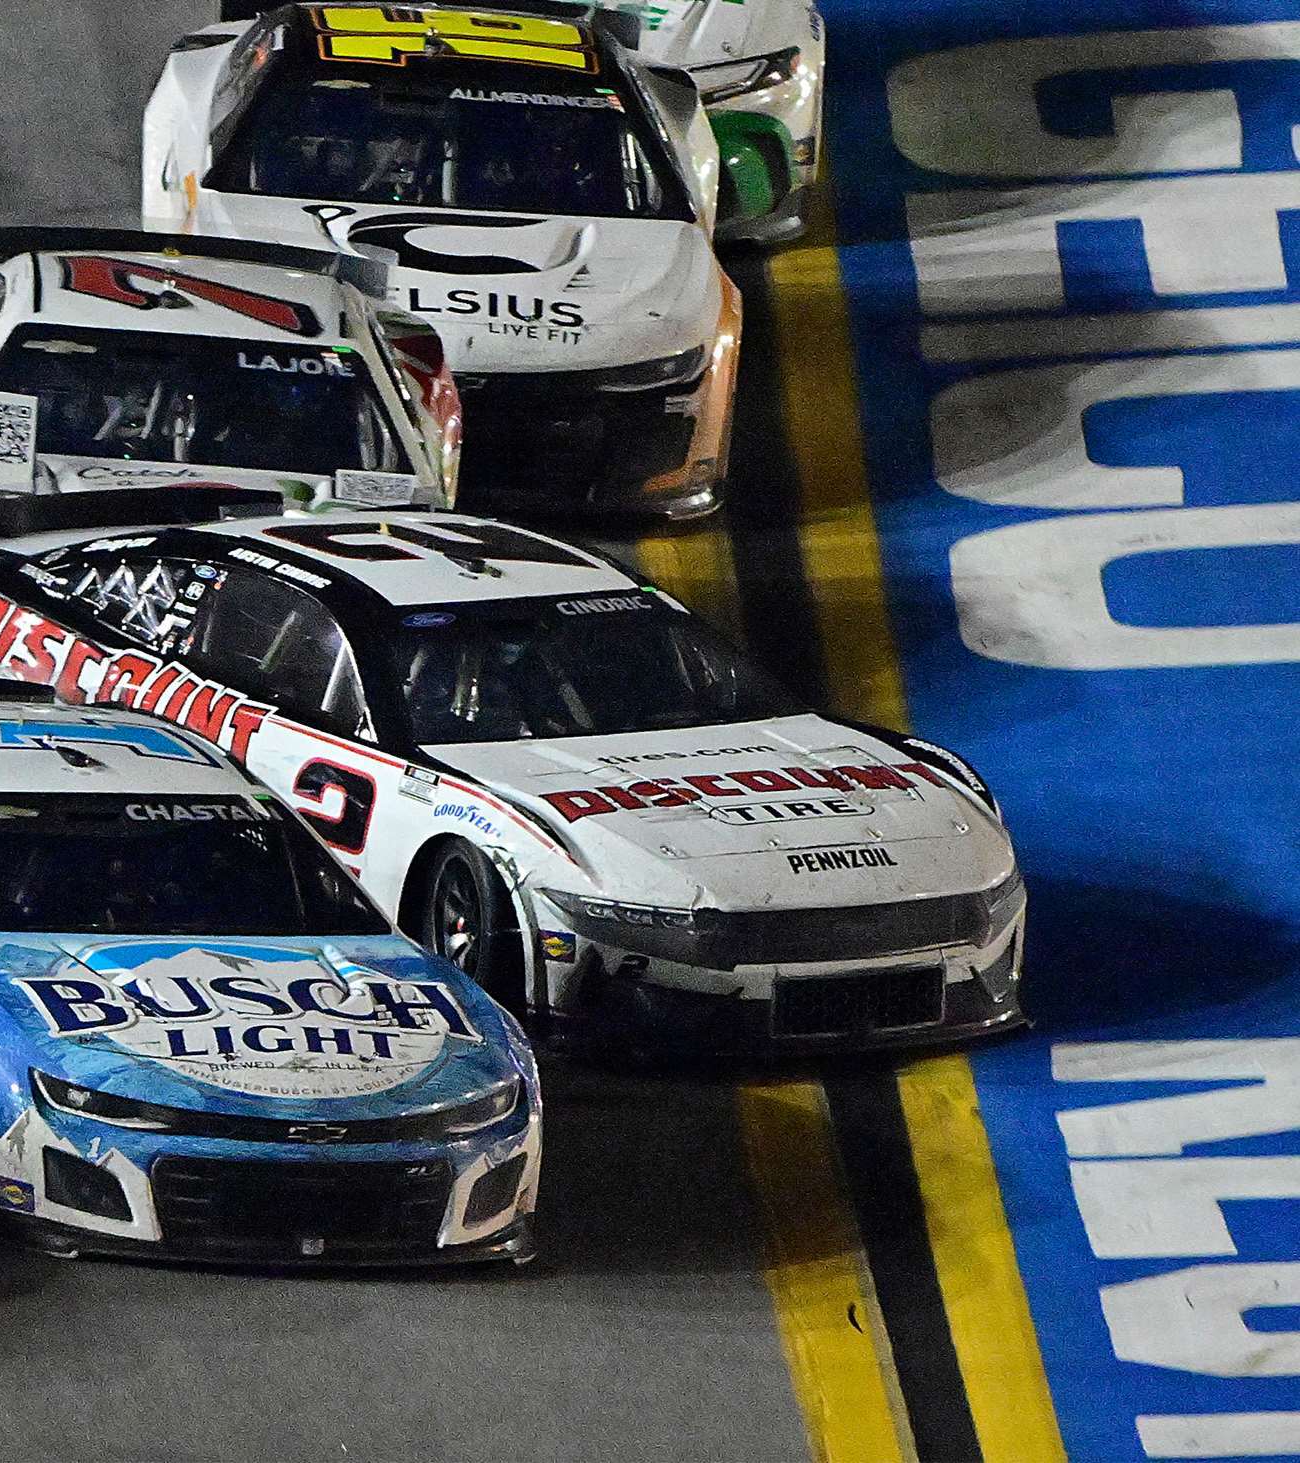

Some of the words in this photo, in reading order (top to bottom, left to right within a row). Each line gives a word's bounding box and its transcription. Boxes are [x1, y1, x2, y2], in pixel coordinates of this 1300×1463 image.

[392, 287, 585, 328] LSIUS
[488, 322, 539, 340] LIVE
[548, 329, 583, 346] FIT
[556, 596, 652, 616] CINDRIC
[598, 743, 777, 768] tires.com
[538, 761, 947, 824] DISCOUNT
[727, 798, 860, 823] TIRE
[787, 848, 898, 875] PENNZOIL
[15, 976, 485, 1044] BUSCH
[166, 1024, 403, 1060] LIGHT
[86, 1136, 101, 1158] 1
